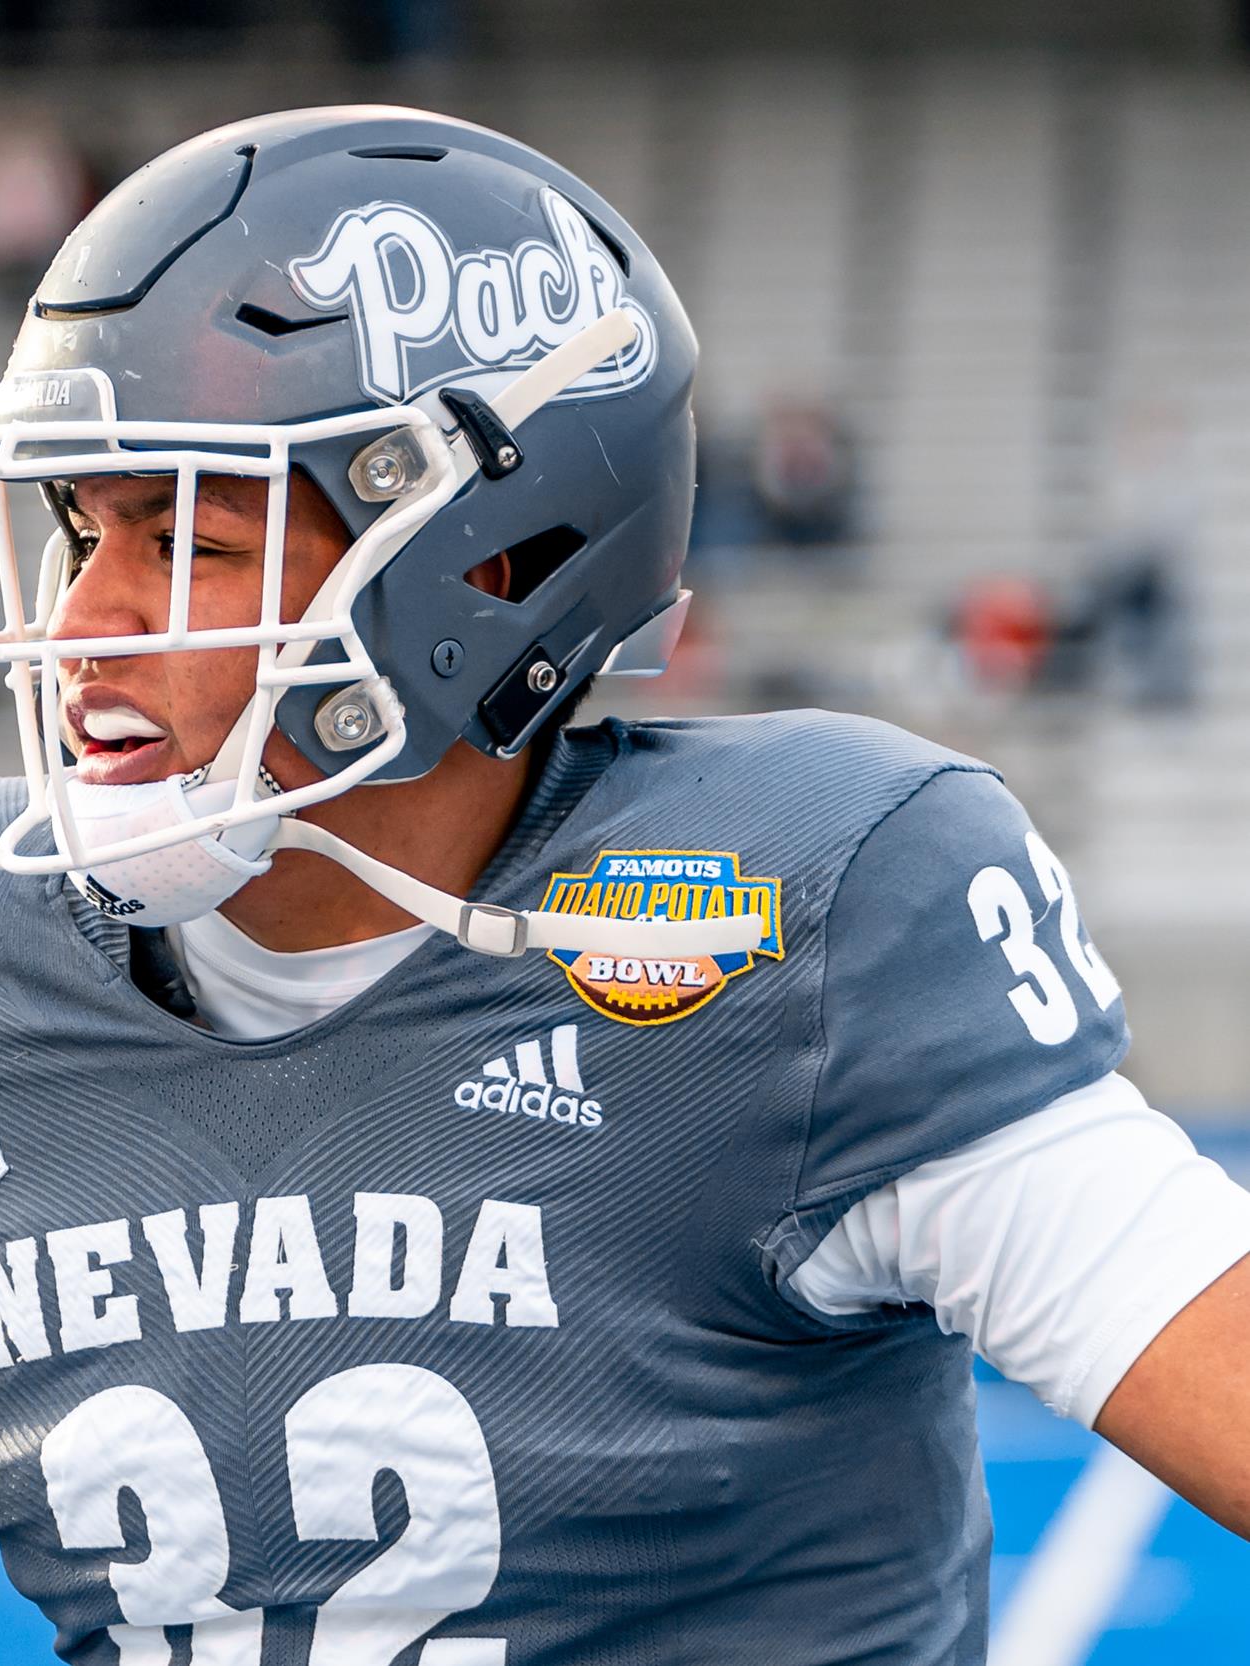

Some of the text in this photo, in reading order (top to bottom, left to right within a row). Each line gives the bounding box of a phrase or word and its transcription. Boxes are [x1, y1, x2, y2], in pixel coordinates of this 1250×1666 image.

[605, 858, 722, 879] FAMOUS
[549, 881, 772, 939] IDAHO POTATO
[967, 831, 1122, 1045] 32
[586, 956, 707, 987] BOWL
[453, 1077, 603, 1127] adidas
[40, 1362, 507, 1666] 32
